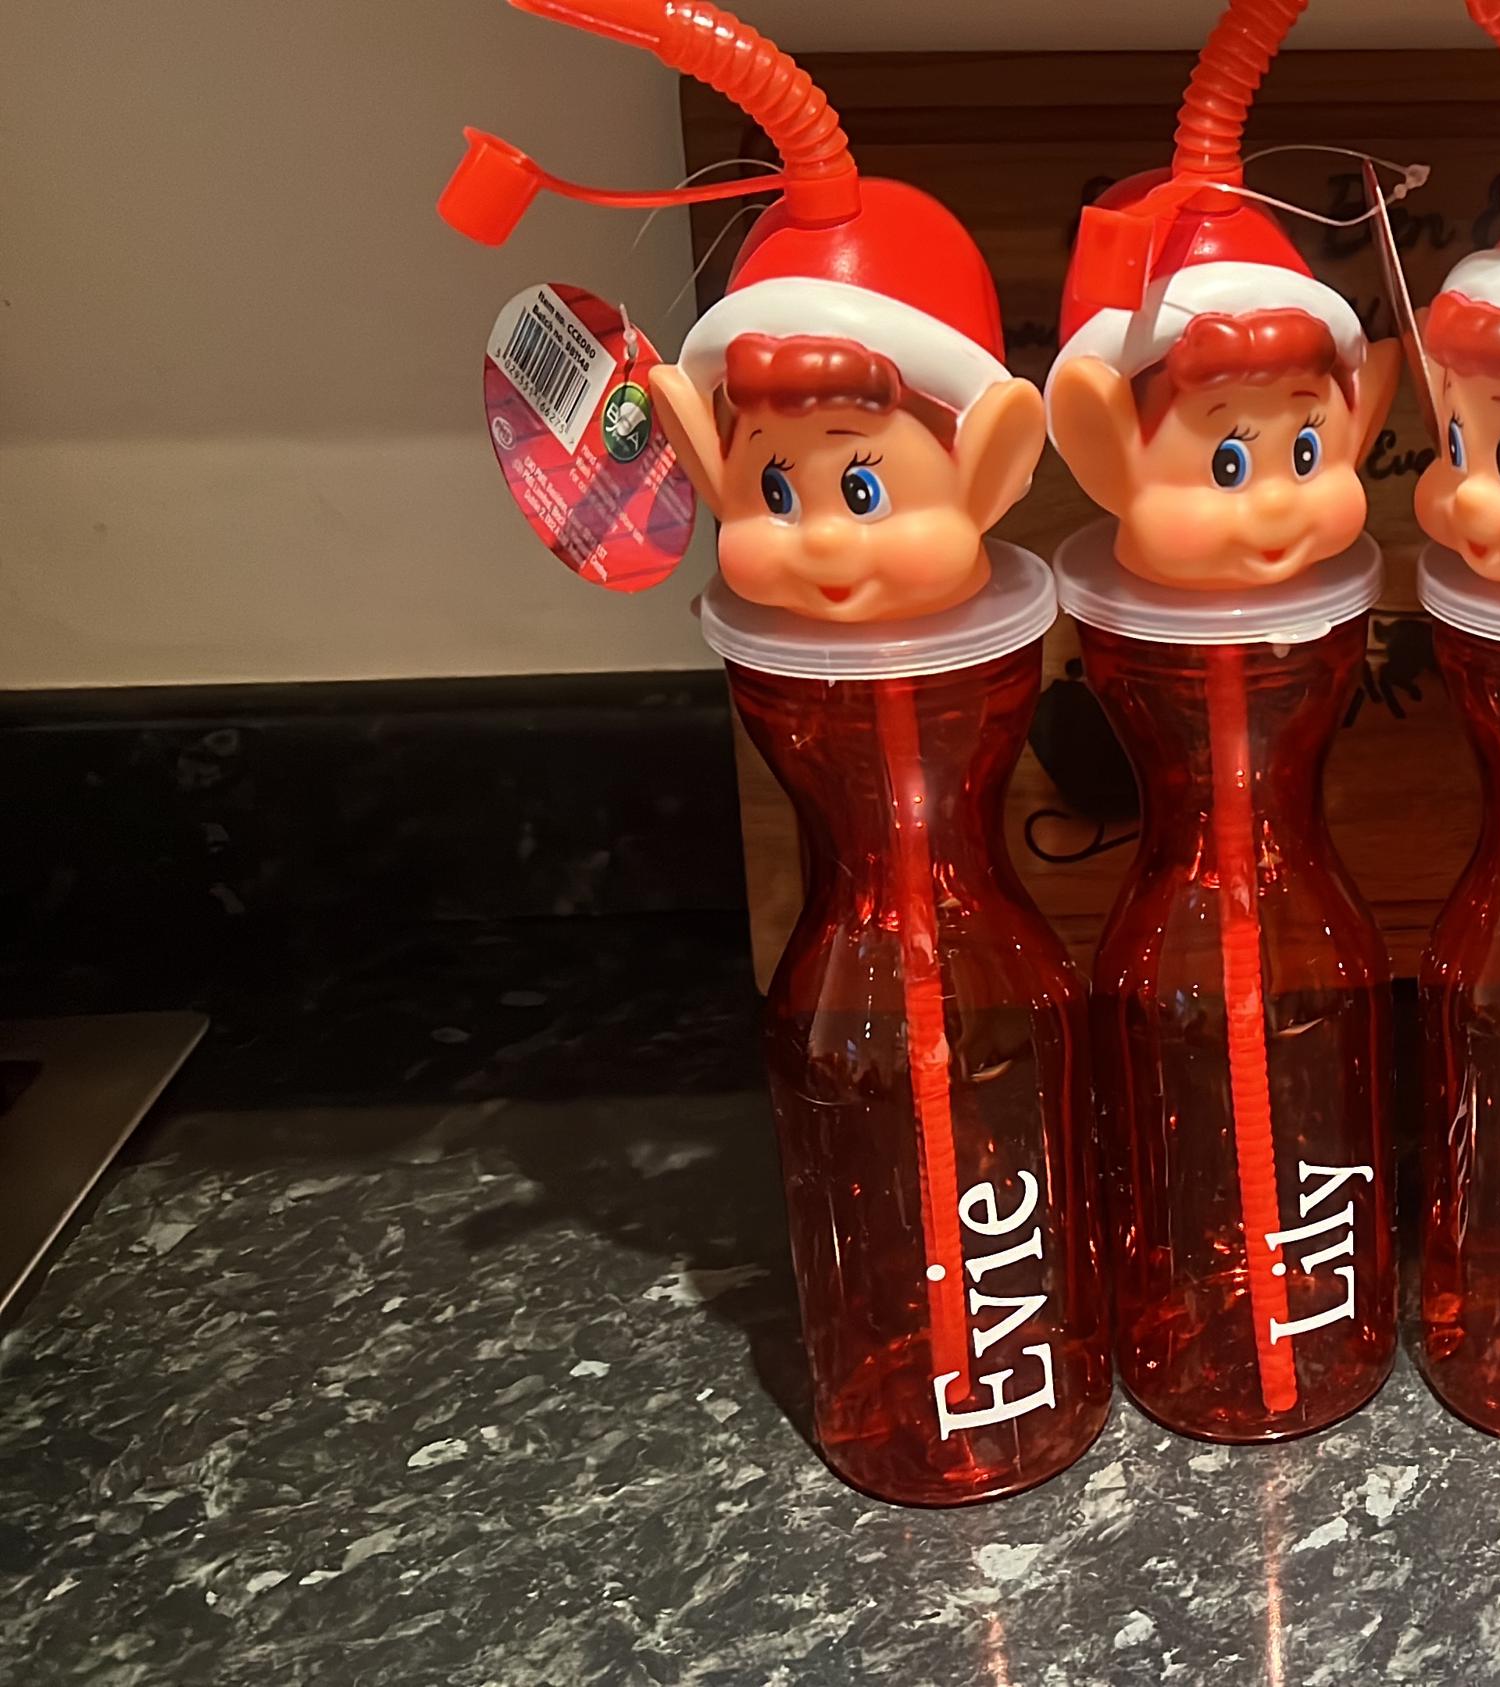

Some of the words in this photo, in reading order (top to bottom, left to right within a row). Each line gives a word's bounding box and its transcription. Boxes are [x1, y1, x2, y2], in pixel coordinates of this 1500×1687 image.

[532, 304, 553, 336] Batch
[538, 290, 555, 313] Item
[926, 1169, 1056, 1442] Evie
[1264, 1160, 1374, 1346] Lily
